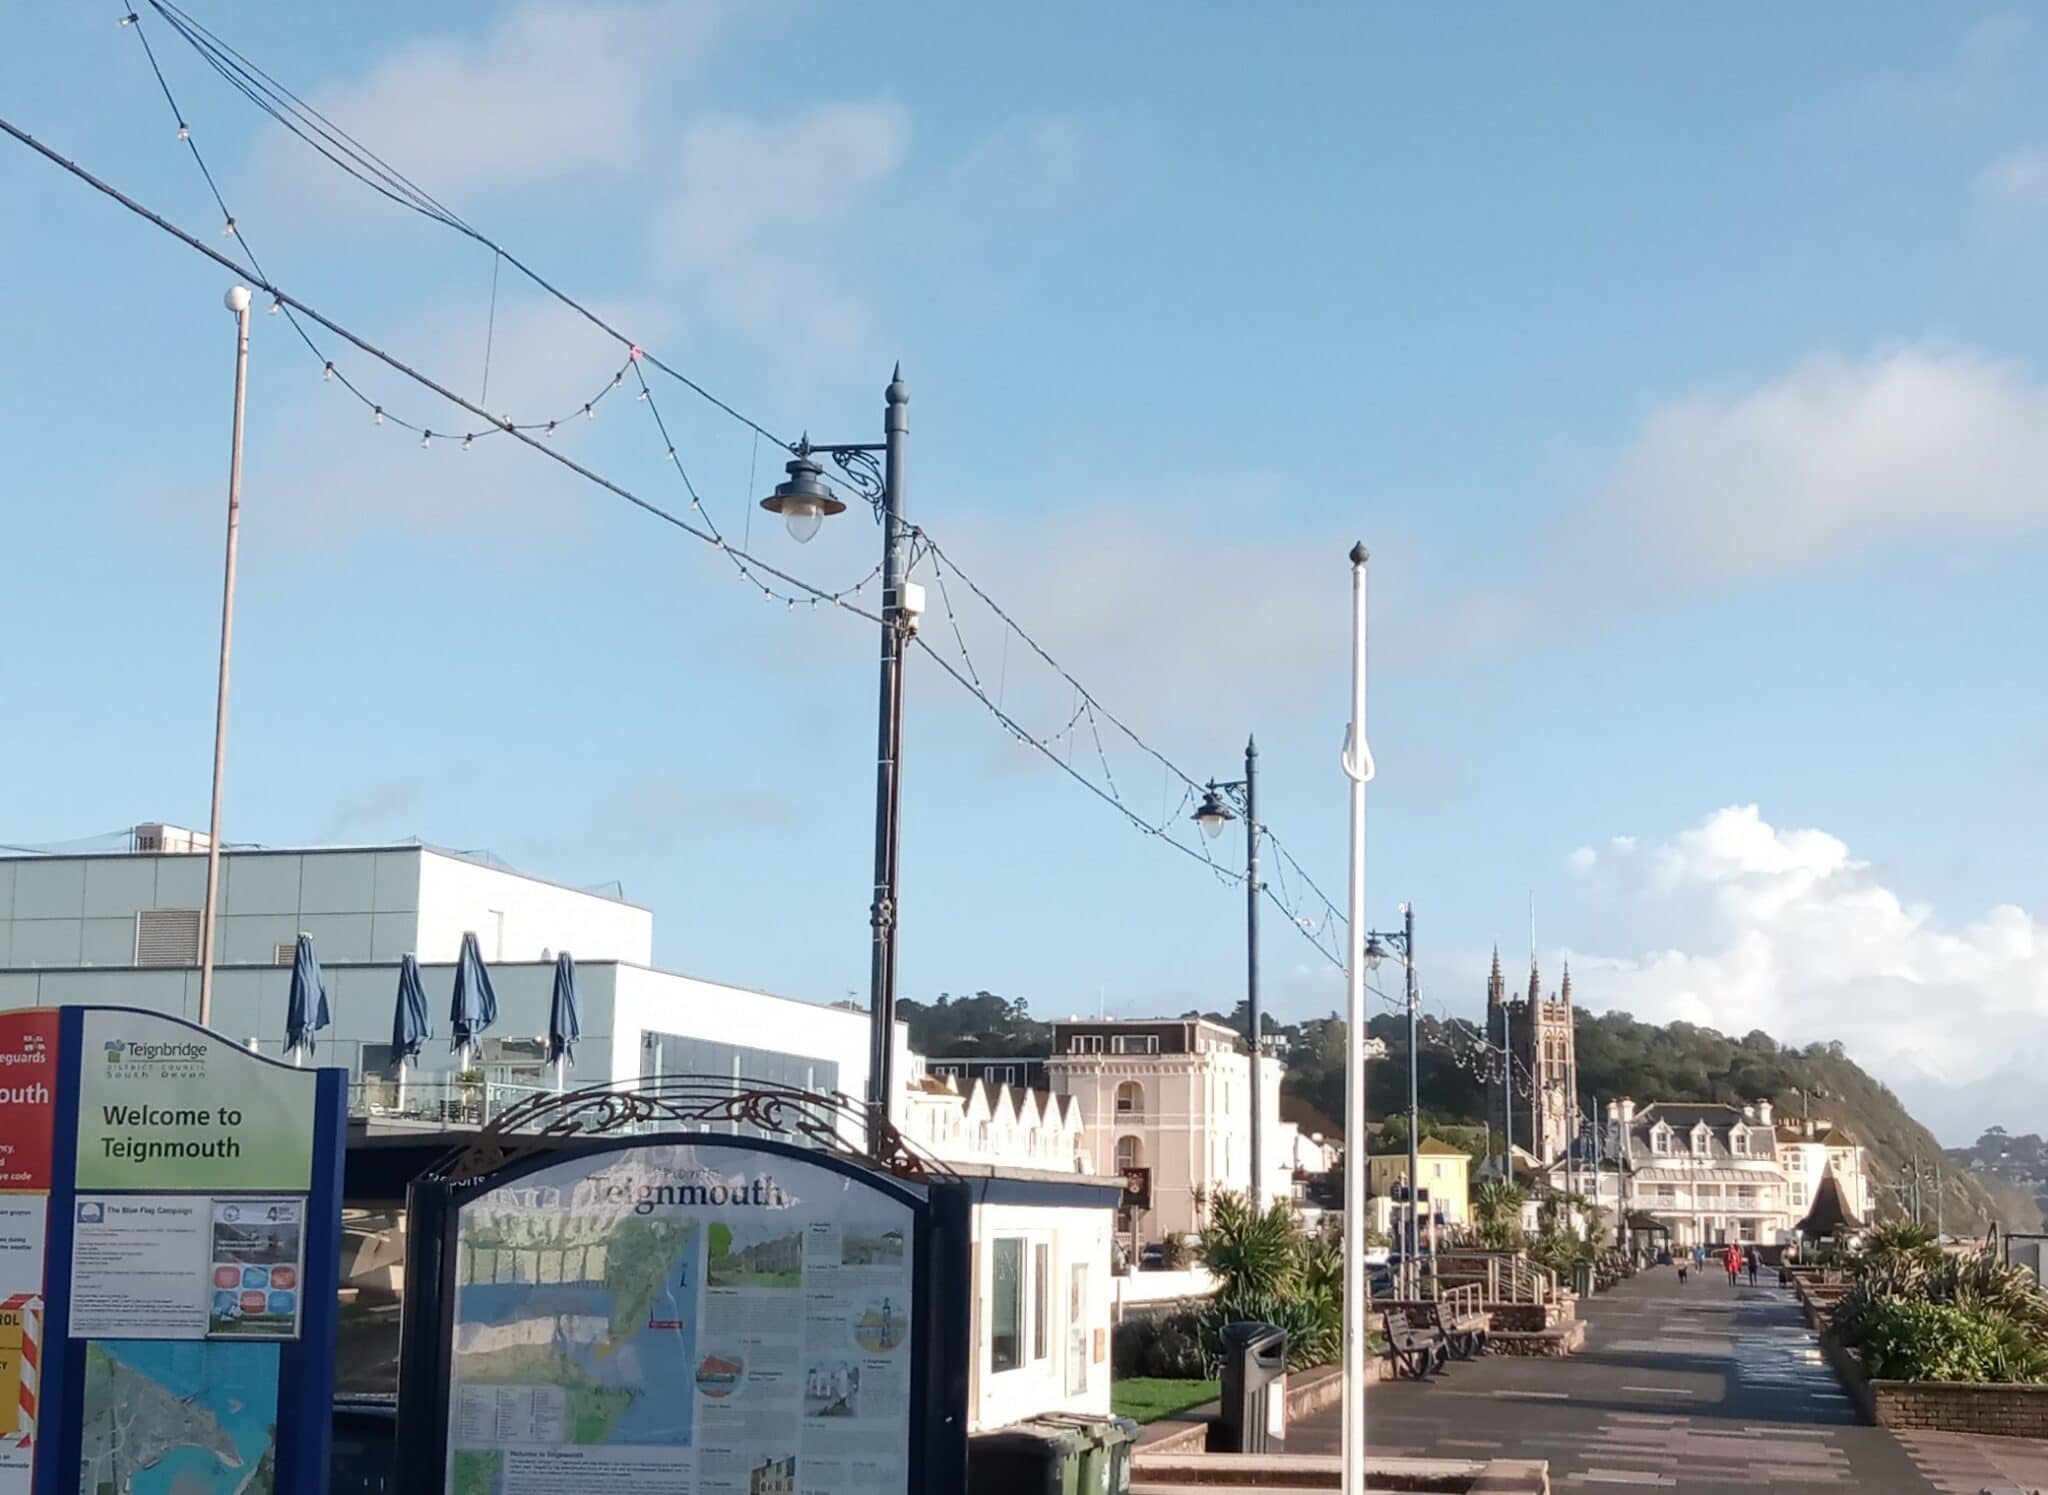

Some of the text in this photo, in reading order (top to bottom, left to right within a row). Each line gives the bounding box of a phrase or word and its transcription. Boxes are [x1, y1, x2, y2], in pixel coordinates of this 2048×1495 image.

[127, 1042, 208, 1059] Teignbridge
[106, 1071, 205, 1079] South Devon
[103, 1104, 242, 1126] Welcome to
[101, 1136, 240, 1164] Teignmouth
[587, 1176, 787, 1214] Teignmouth
[107, 1206, 193, 1216] The Blue Flag Campaign
